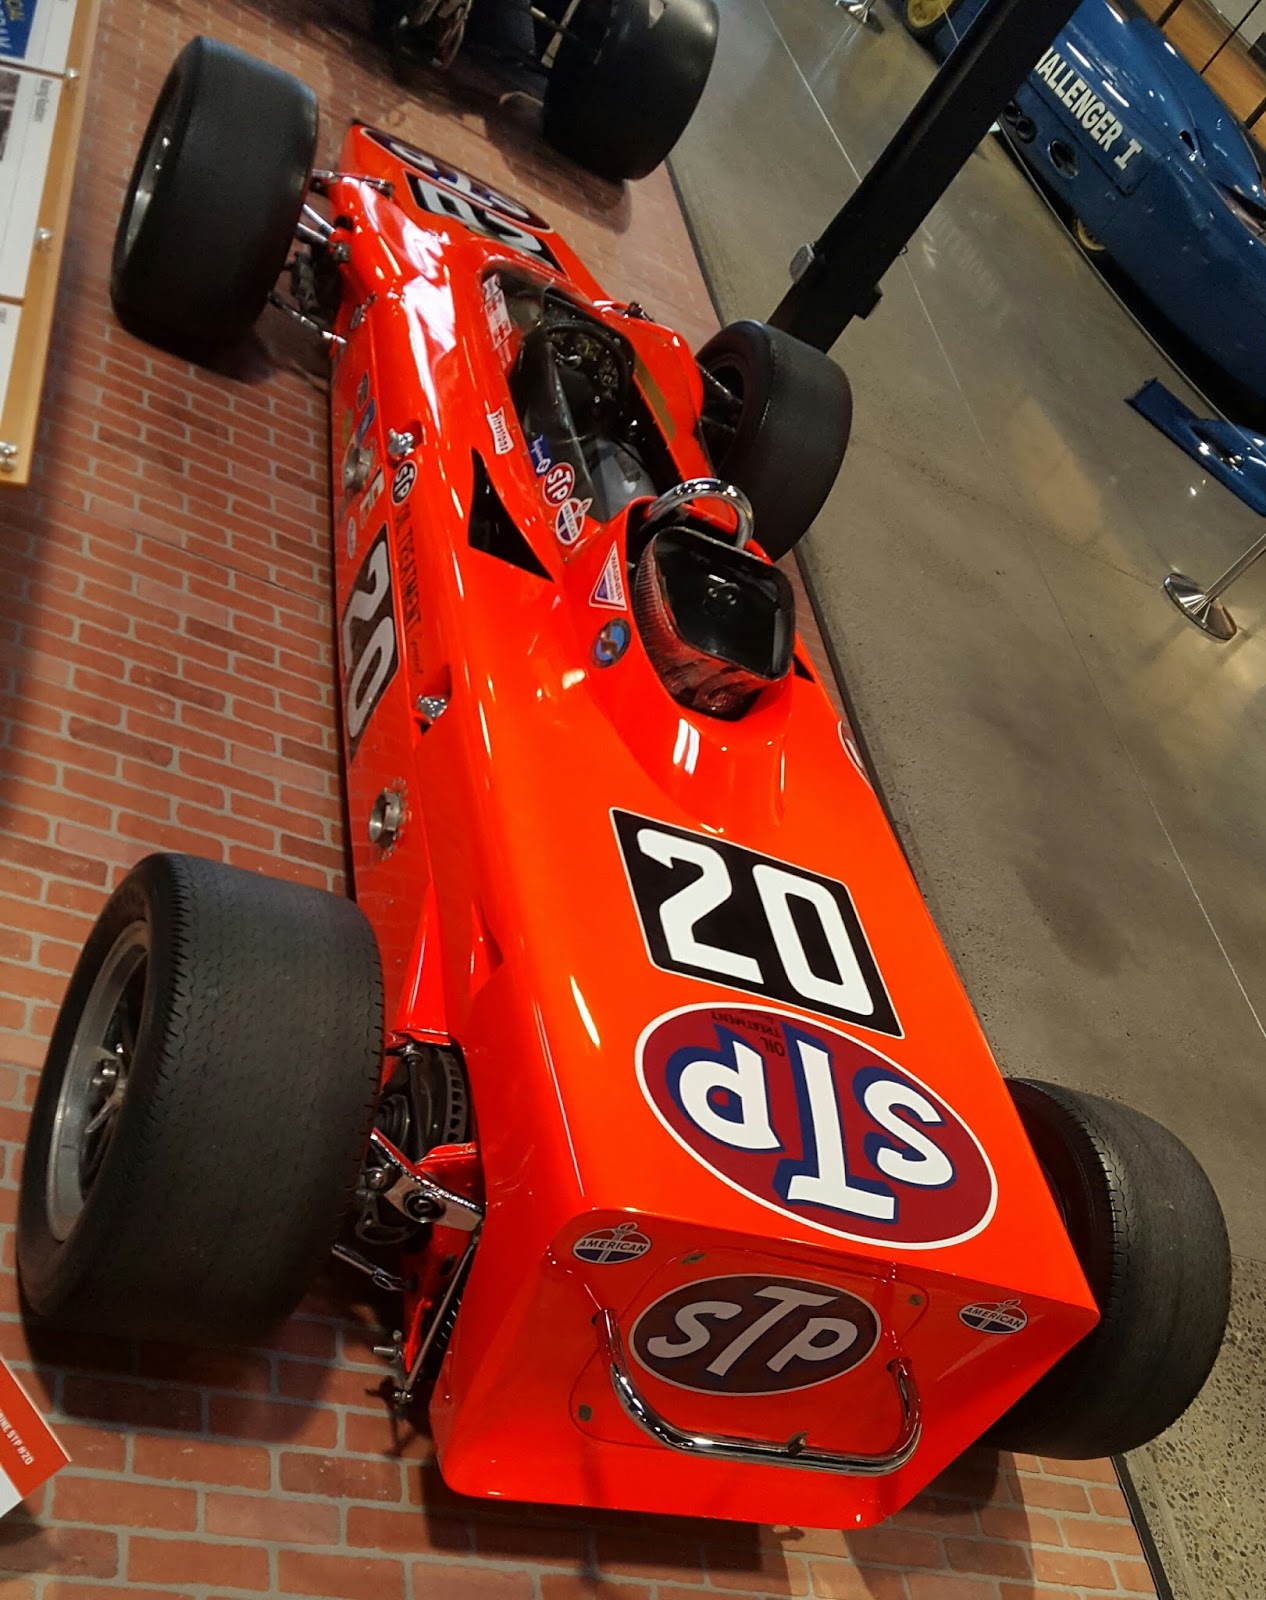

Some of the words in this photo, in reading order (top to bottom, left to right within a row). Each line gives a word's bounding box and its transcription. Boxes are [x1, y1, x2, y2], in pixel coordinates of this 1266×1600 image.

[1034, 46, 1123, 151] ALLENGER
[1113, 138, 1142, 170] I
[394, 465, 414, 497] STP
[547, 468, 572, 500] STP
[564, 504, 578, 538] AMERICAN
[343, 541, 395, 737] 20
[637, 828, 874, 1016] 20
[711, 1011, 783, 1039] TREATMENT
[759, 1036, 785, 1057] OIL
[679, 1038, 953, 1220] STP
[577, 1239, 648, 1253] AMERICAN
[647, 1286, 858, 1377] STP
[965, 1307, 1024, 1328] AMERICAN
[6, 1429, 23, 1450] STP
[17, 1444, 35, 1466] #20
